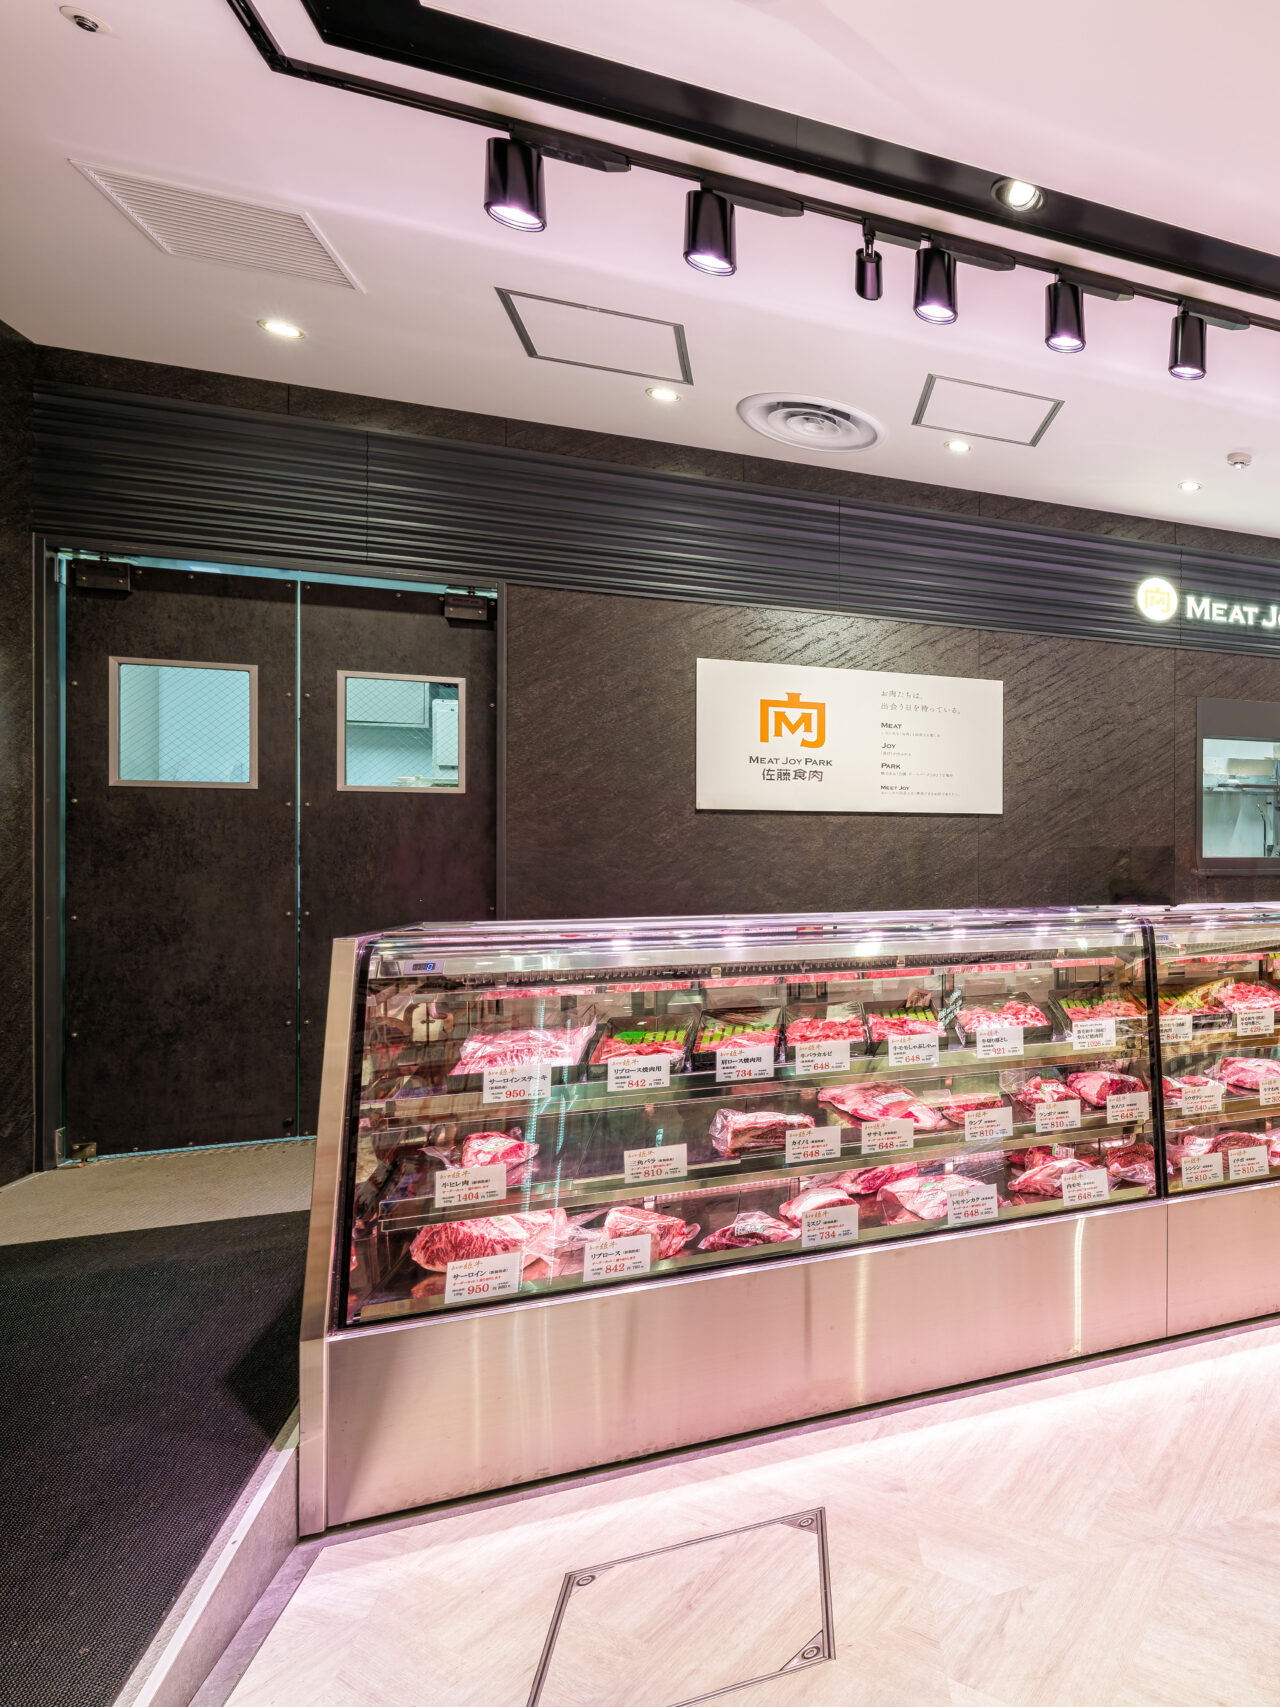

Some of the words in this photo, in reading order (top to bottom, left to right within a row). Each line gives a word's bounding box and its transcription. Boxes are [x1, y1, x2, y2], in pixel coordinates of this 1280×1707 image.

[1186, 596, 1258, 626] MEAT
[881, 722, 902, 730] MEAT
[882, 742, 896, 750] JOY
[749, 755, 780, 764] MEAT
[782, 757, 803, 765] JOY
[804, 758, 833, 767] PARK
[881, 762, 901, 770] PARK
[762, 768, 823, 782] 佐藤食肉
[905, 1055, 920, 1063] 648
[814, 1062, 830, 1070] 648
[736, 1069, 752, 1078] 734
[627, 1079, 646, 1089] 842
[505, 1089, 526, 1098] 950
[979, 1129, 994, 1137] 810
[878, 1141, 894, 1150] 648
[803, 1150, 820, 1158] 648
[643, 1168, 662, 1177] 810
[457, 1192, 479, 1202] 1404
[1077, 1192, 1092, 1200] 648
[964, 1209, 980, 1218] 648
[819, 1230, 836, 1240] 734
[591, 1250, 621, 1260] リブロース
[605, 1263, 625, 1274] 842
[452, 1270, 488, 1281] サーロイン
[467, 1283, 489, 1296] 950
